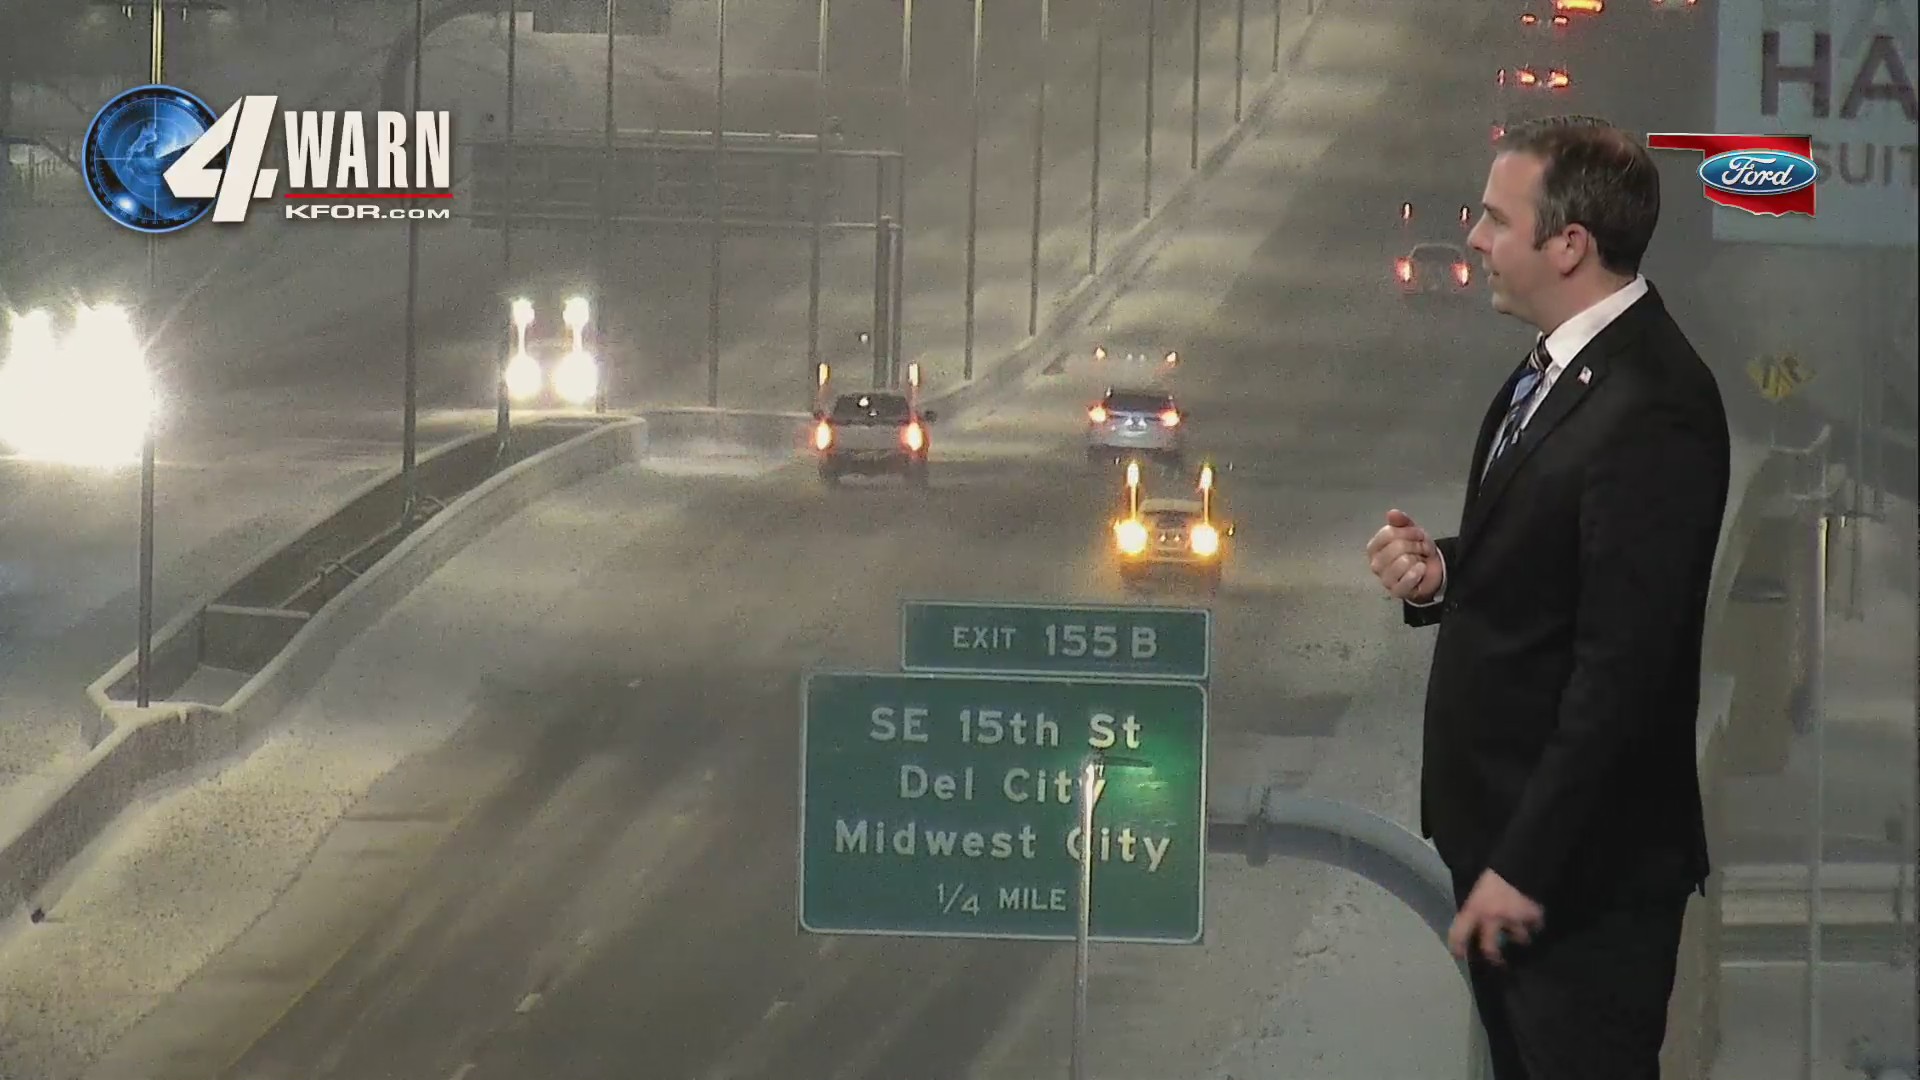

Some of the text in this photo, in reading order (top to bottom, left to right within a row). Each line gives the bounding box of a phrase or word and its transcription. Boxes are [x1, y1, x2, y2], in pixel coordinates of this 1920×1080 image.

[953, 627, 1016, 649] EXIT
[870, 707, 1142, 749] SE 15th St
[900, 765, 974, 800] Del
[836, 820, 1171, 872] Midwest City
[999, 888, 1067, 911] MILE
